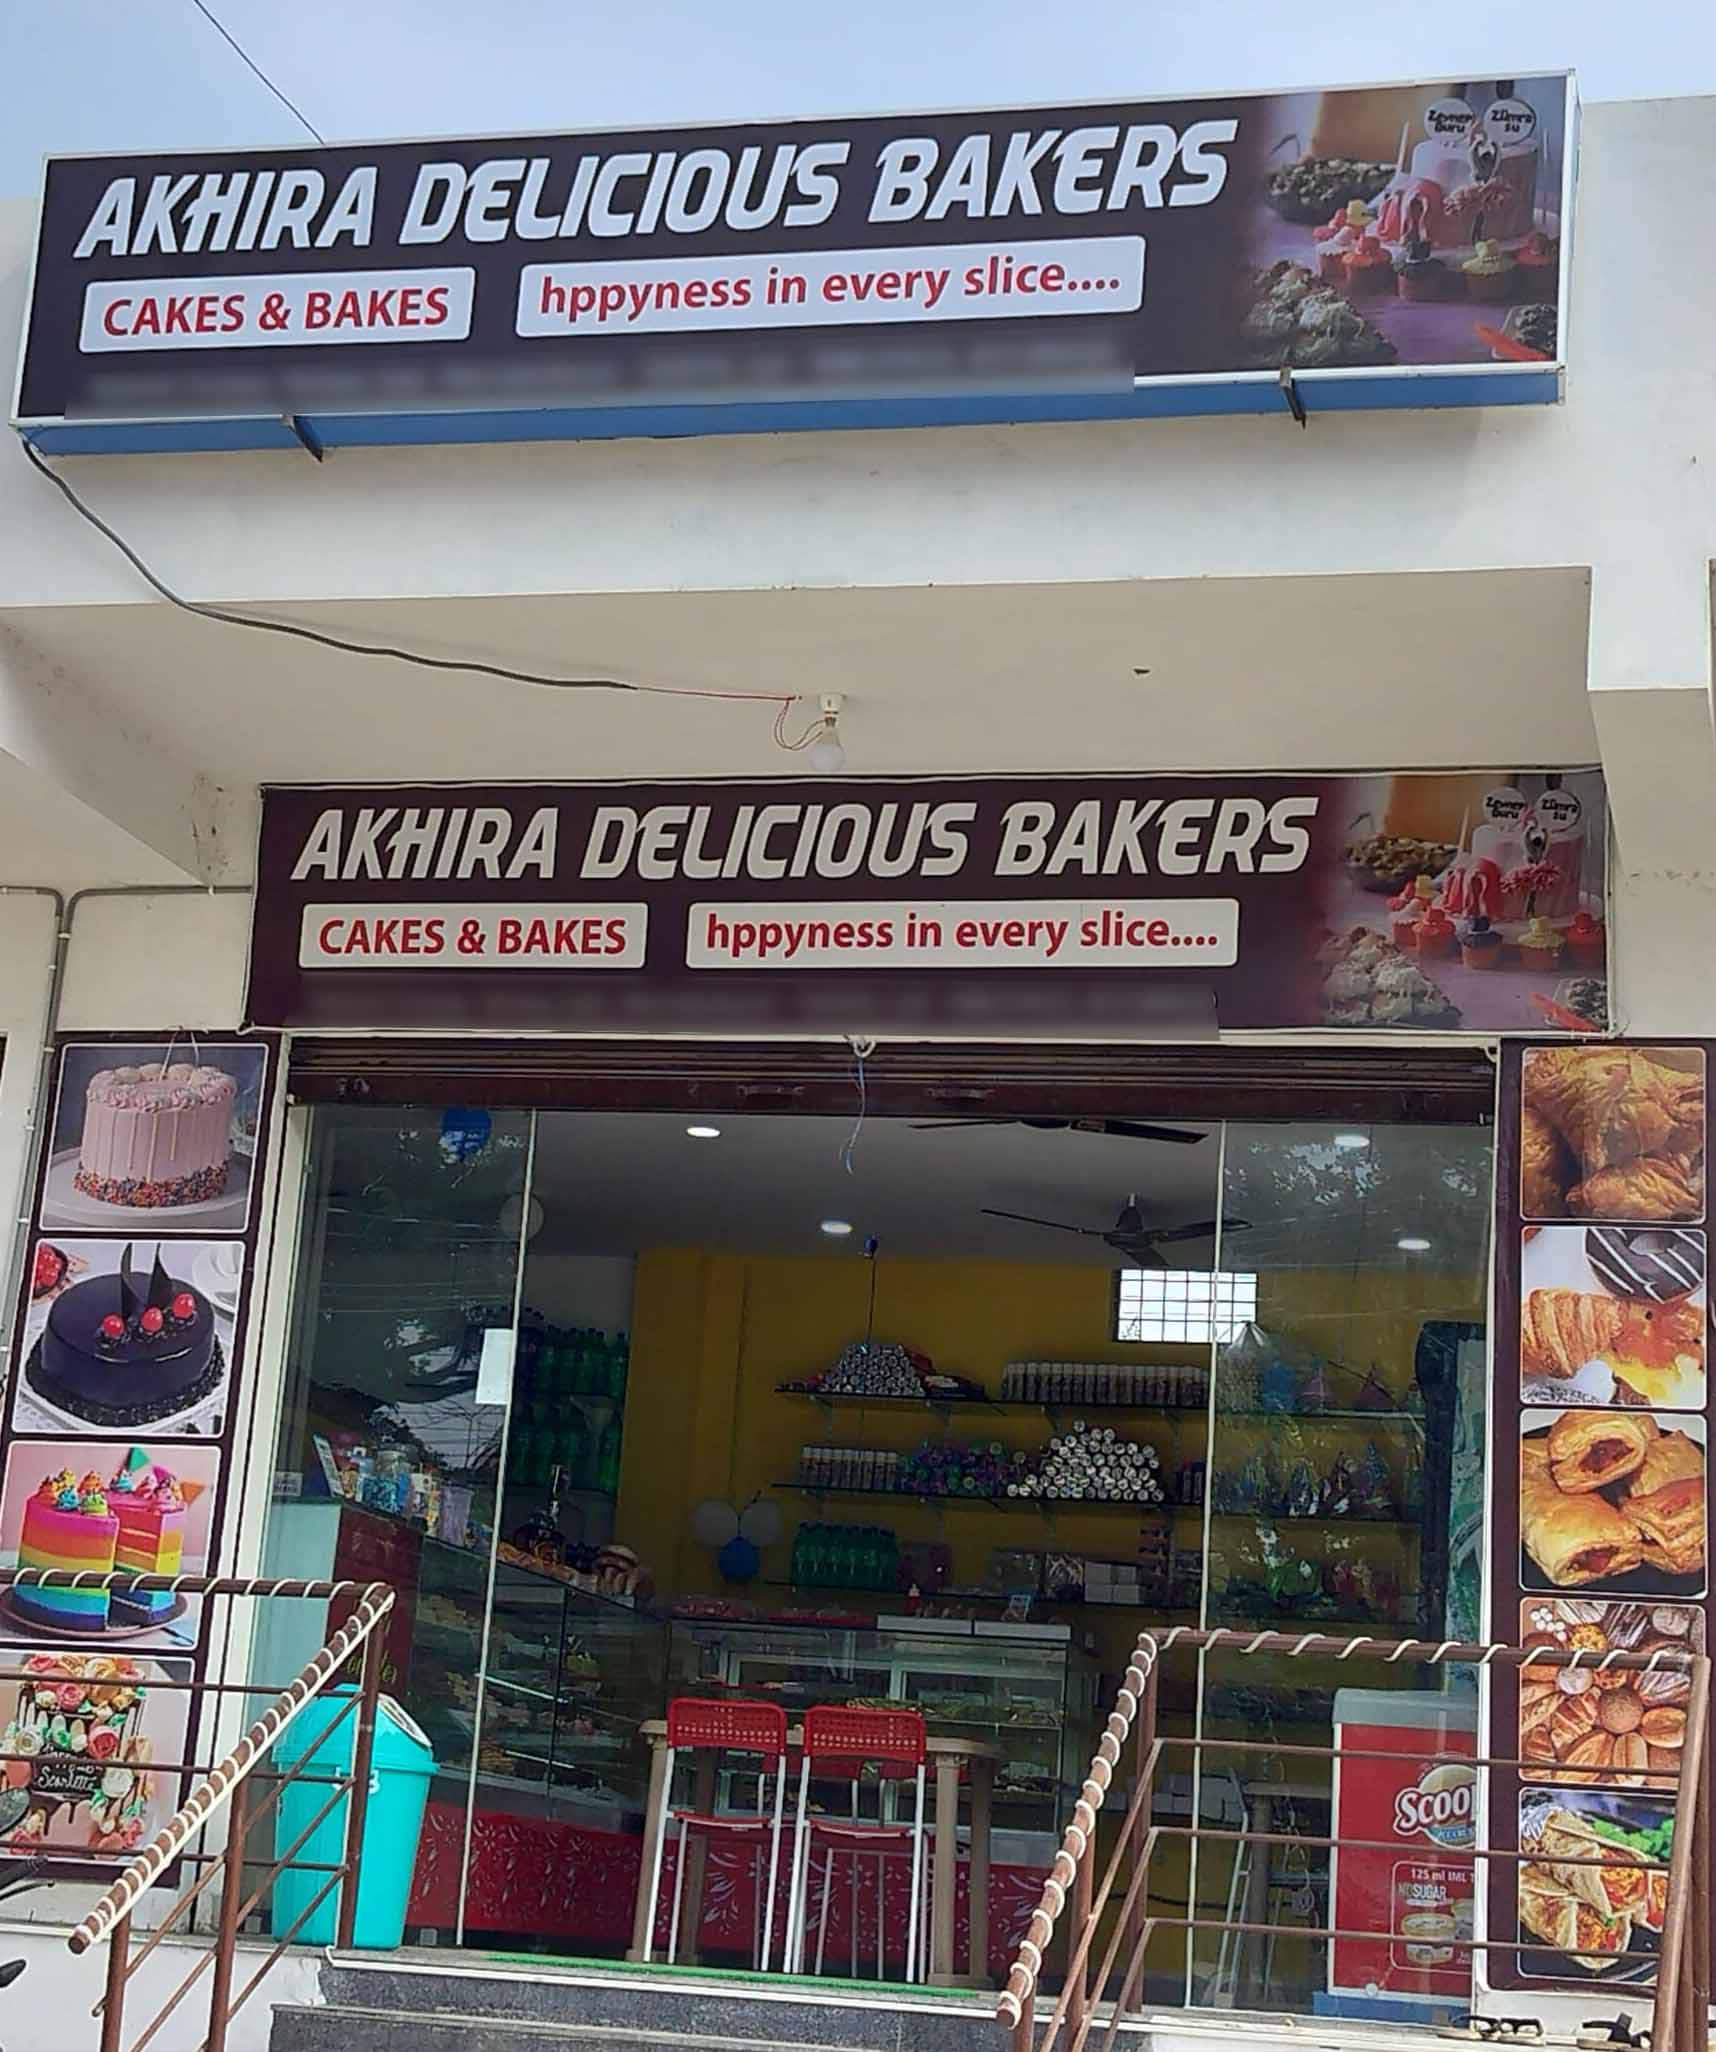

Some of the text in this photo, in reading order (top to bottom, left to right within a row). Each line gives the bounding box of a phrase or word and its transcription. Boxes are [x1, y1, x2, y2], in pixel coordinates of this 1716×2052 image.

[73, 118, 1240, 259] AKHIRA DELICIOUS BAKERS
[103, 286, 450, 337] CAKES & BAKES
[541, 274, 751, 322] hppyness
[766, 266, 806, 303] in
[822, 270, 948, 309] every
[290, 796, 1319, 881] AKHIRA DELICIOUS BAKERS
[318, 917, 627, 956] CAKES & BAKES
[706, 912, 893, 958] hppyness
[906, 911, 941, 948] in
[954, 919, 1068, 957] every
[1411, 1867, 1429, 1880] 125
